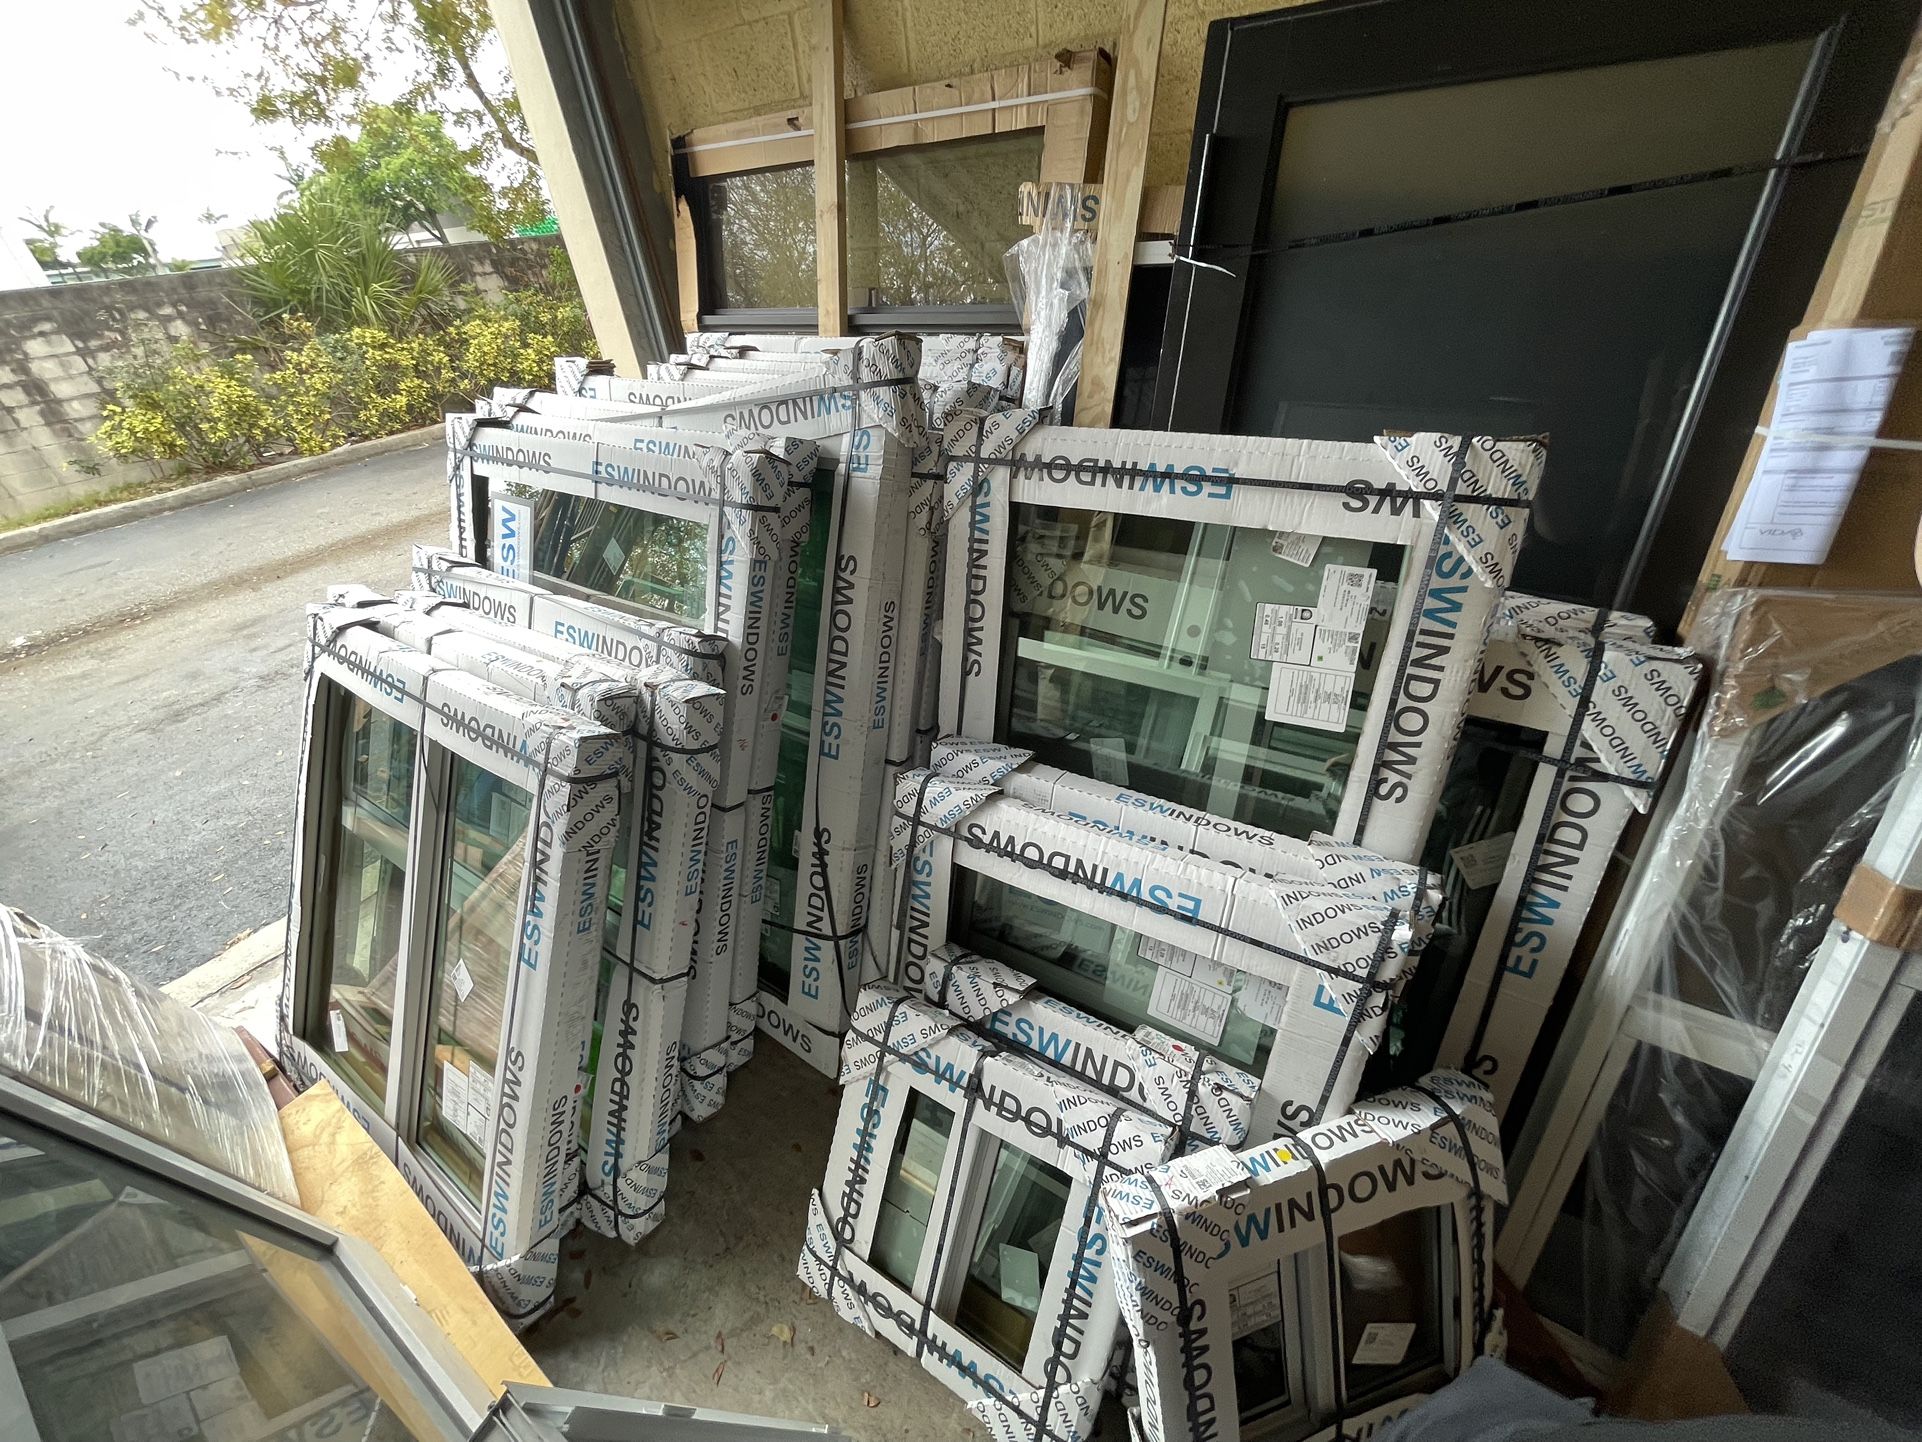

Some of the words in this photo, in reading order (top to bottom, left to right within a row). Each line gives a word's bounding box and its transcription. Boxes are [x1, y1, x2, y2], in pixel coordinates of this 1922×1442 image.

[740, 559, 767, 696] ESWINDOWS
[820, 554, 857, 760] ESWINDOWS
[873, 600, 896, 729] ESWINDOWS
[1372, 536, 1474, 805] SWINDOWS
[751, 793, 773, 905] ESWINDOWS
[1114, 792, 1277, 847] ESWINDOWS
[715, 838, 739, 957] ESWINDOWS
[486, 1046, 525, 1262] ESWINDOWS
[538, 1094, 568, 1231] ESWINDOWS
